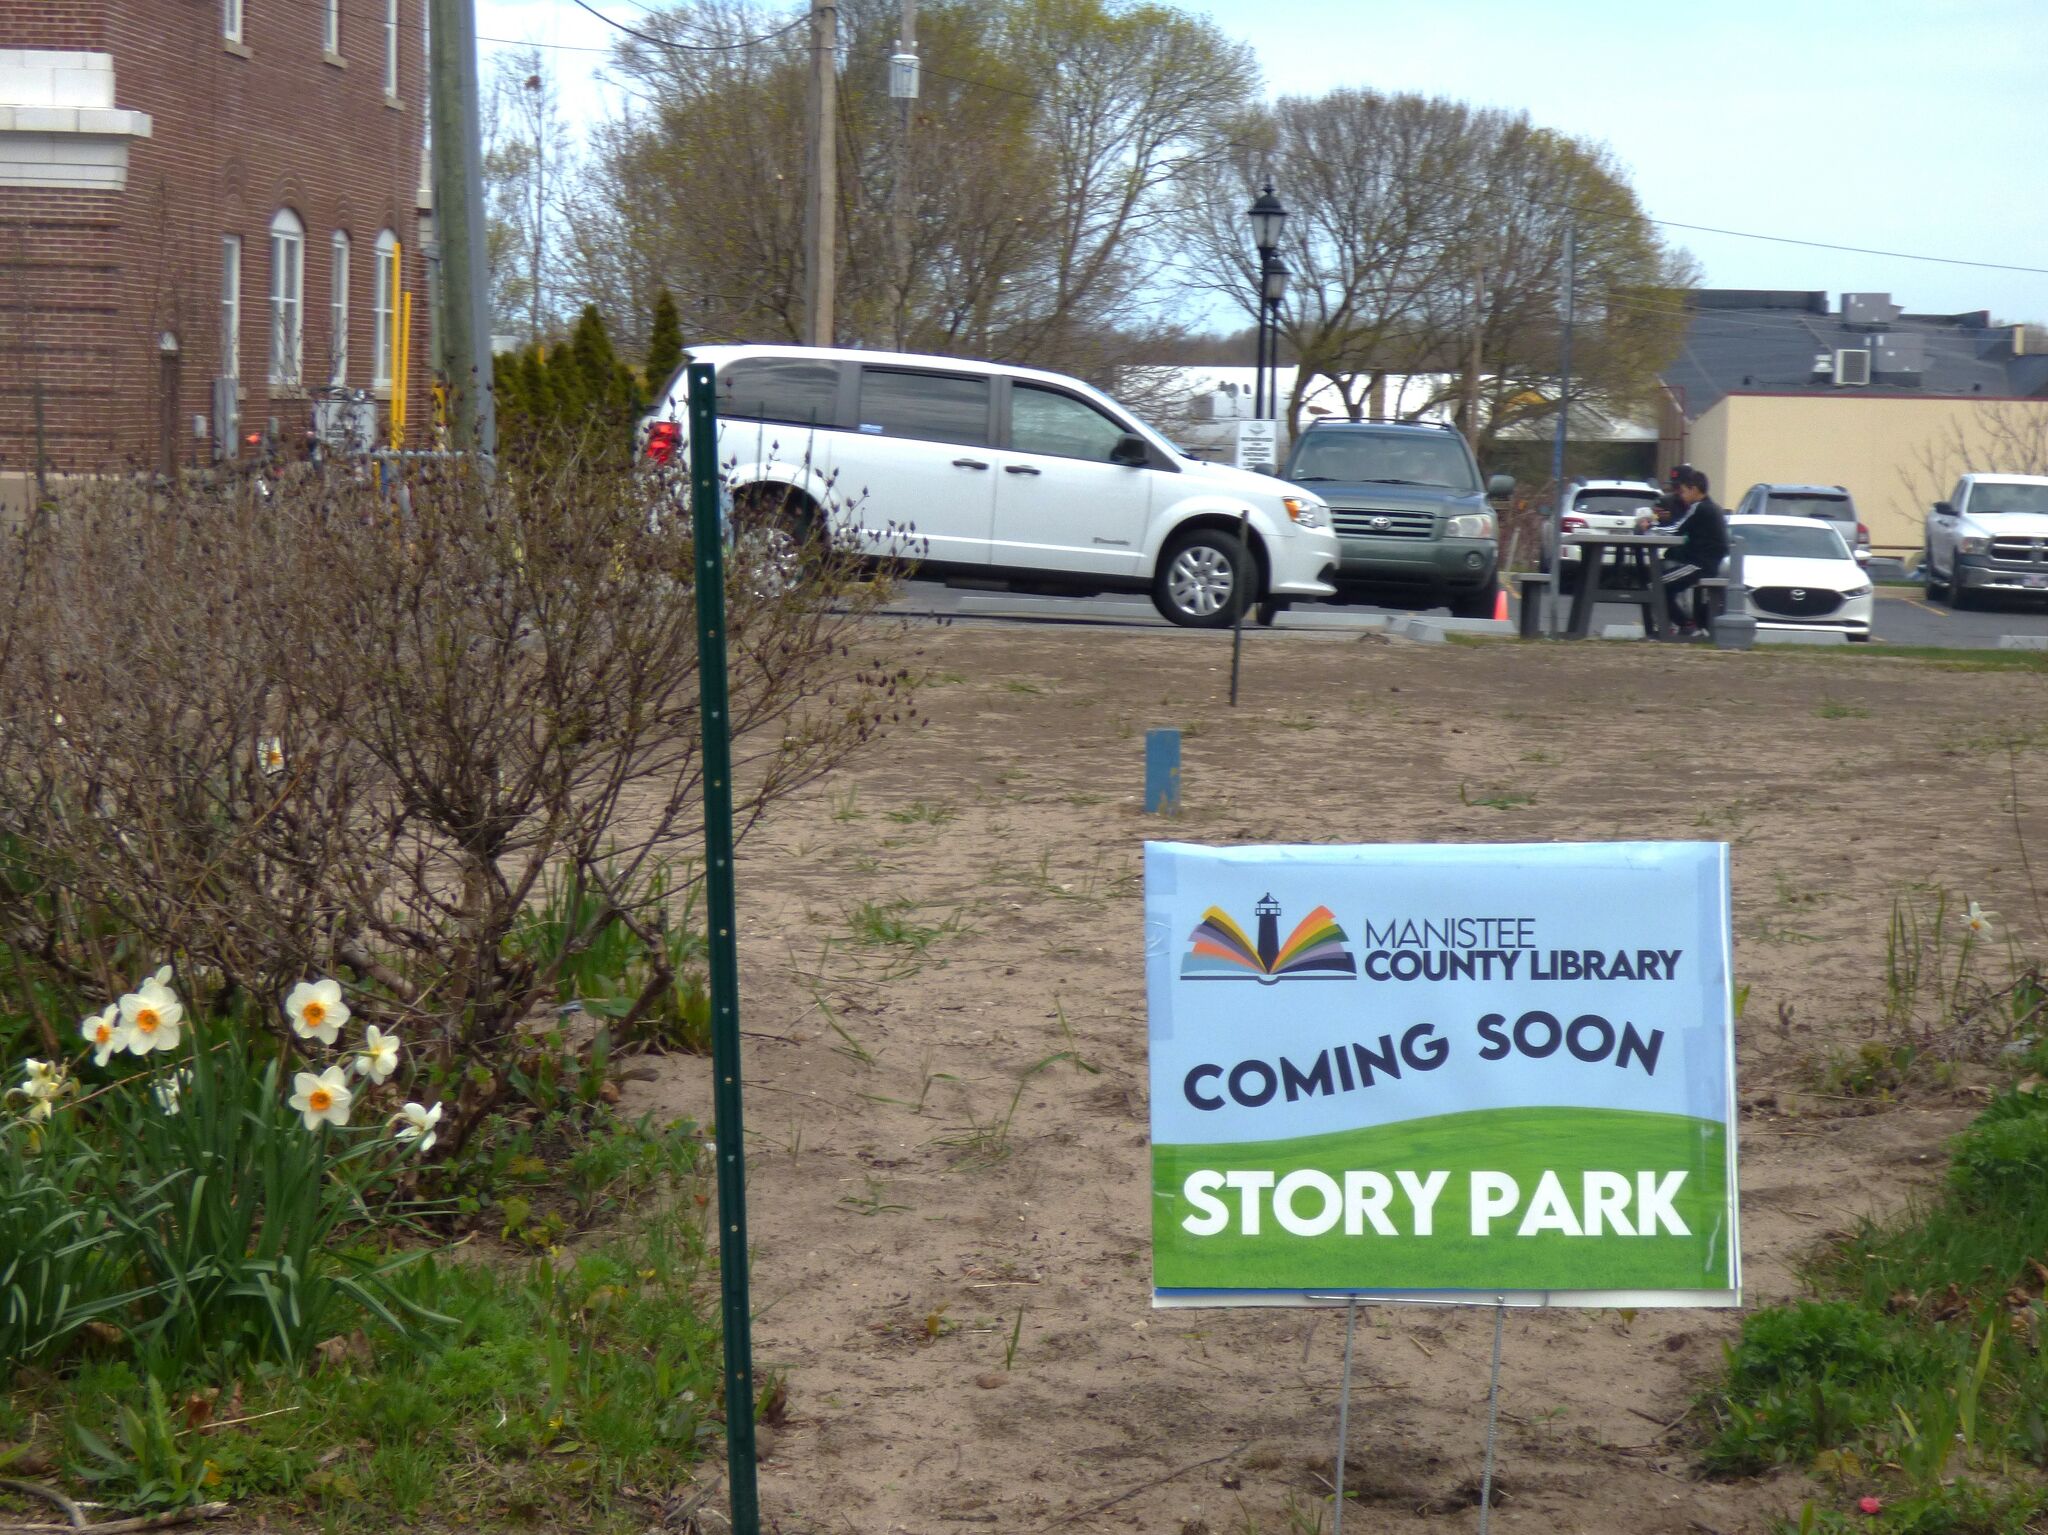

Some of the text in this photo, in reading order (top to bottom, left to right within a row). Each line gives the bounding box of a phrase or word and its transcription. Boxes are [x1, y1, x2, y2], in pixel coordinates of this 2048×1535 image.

[1366, 917, 1536, 949] MANISTEE
[1364, 949, 1684, 982] COUNTY LIBRARY
[1183, 1010, 1665, 1112] COMING SOON
[1181, 1169, 1692, 1237] STORY PARK
